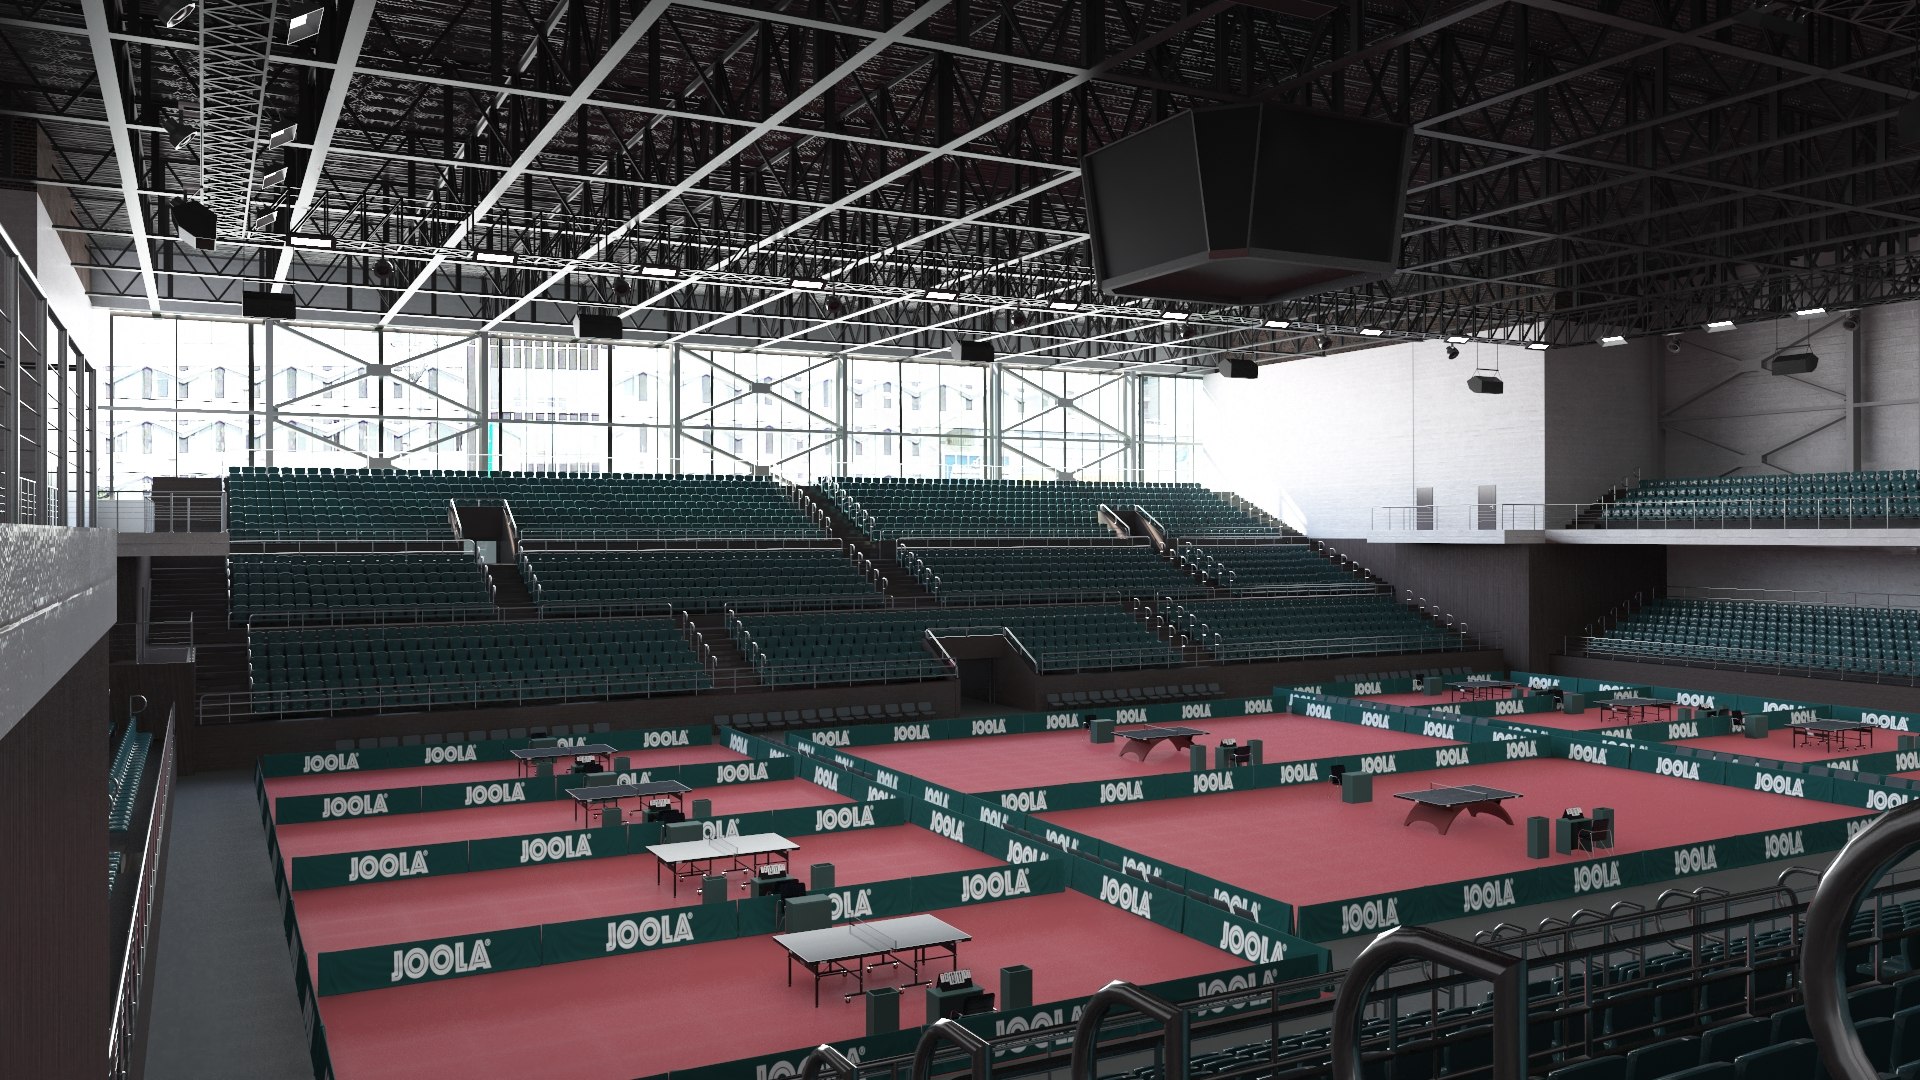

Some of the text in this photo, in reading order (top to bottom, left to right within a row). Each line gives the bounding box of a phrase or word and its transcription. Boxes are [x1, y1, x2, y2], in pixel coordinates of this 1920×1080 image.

[1116, 708, 1147, 724] JOOLA
[1182, 704, 1211, 719] JOOLA
[1306, 703, 1331, 719] JOOLA
[1495, 701, 1524, 715] JOOLA
[972, 719, 1006, 735] JOOLA
[1046, 713, 1079, 729] JOOLA
[1361, 711, 1389, 729] JOOLA
[1423, 721, 1454, 740] JOOLA
[1668, 722, 1698, 739] JOOLA
[557, 737, 585, 748] OLA
[643, 730, 689, 748] JOOLA
[894, 725, 930, 741] JOOLA
[424, 744, 477, 764] JOOLA
[1435, 748, 1469, 767] JOOLA
[1506, 740, 1537, 759] JOOLA
[1568, 743, 1607, 765] JOOLA
[303, 752, 359, 773] JOOLA
[717, 762, 768, 783] JOOLA
[1281, 763, 1318, 783] JOOLA
[1656, 757, 1699, 780] JOOLA
[617, 772, 651, 786] OLA
[813, 766, 838, 792] JOOLA
[1193, 772, 1233, 793] JOOLA
[1754, 772, 1804, 798] JOOLA
[465, 783, 525, 806] JOOLA
[1100, 781, 1143, 804] JOOLA
[322, 793, 388, 818] JOOLA
[815, 805, 875, 831] JOOLA
[930, 809, 963, 843] JOOLA
[702, 819, 740, 840] OLA
[520, 834, 592, 863] JOOLA
[1765, 831, 1804, 859] JOOLA
[348, 850, 428, 882] JOOLA
[1674, 846, 1717, 875] JOOLA
[961, 868, 1031, 902] JOOLA
[1574, 861, 1620, 892] JOOLA
[831, 889, 872, 920] OLA
[1100, 875, 1151, 919] JOOLA
[1463, 879, 1514, 913] JOOLA
[1341, 899, 1398, 935] JOOLA
[606, 912, 694, 952] JOOLA
[391, 938, 492, 982] JOOLA
